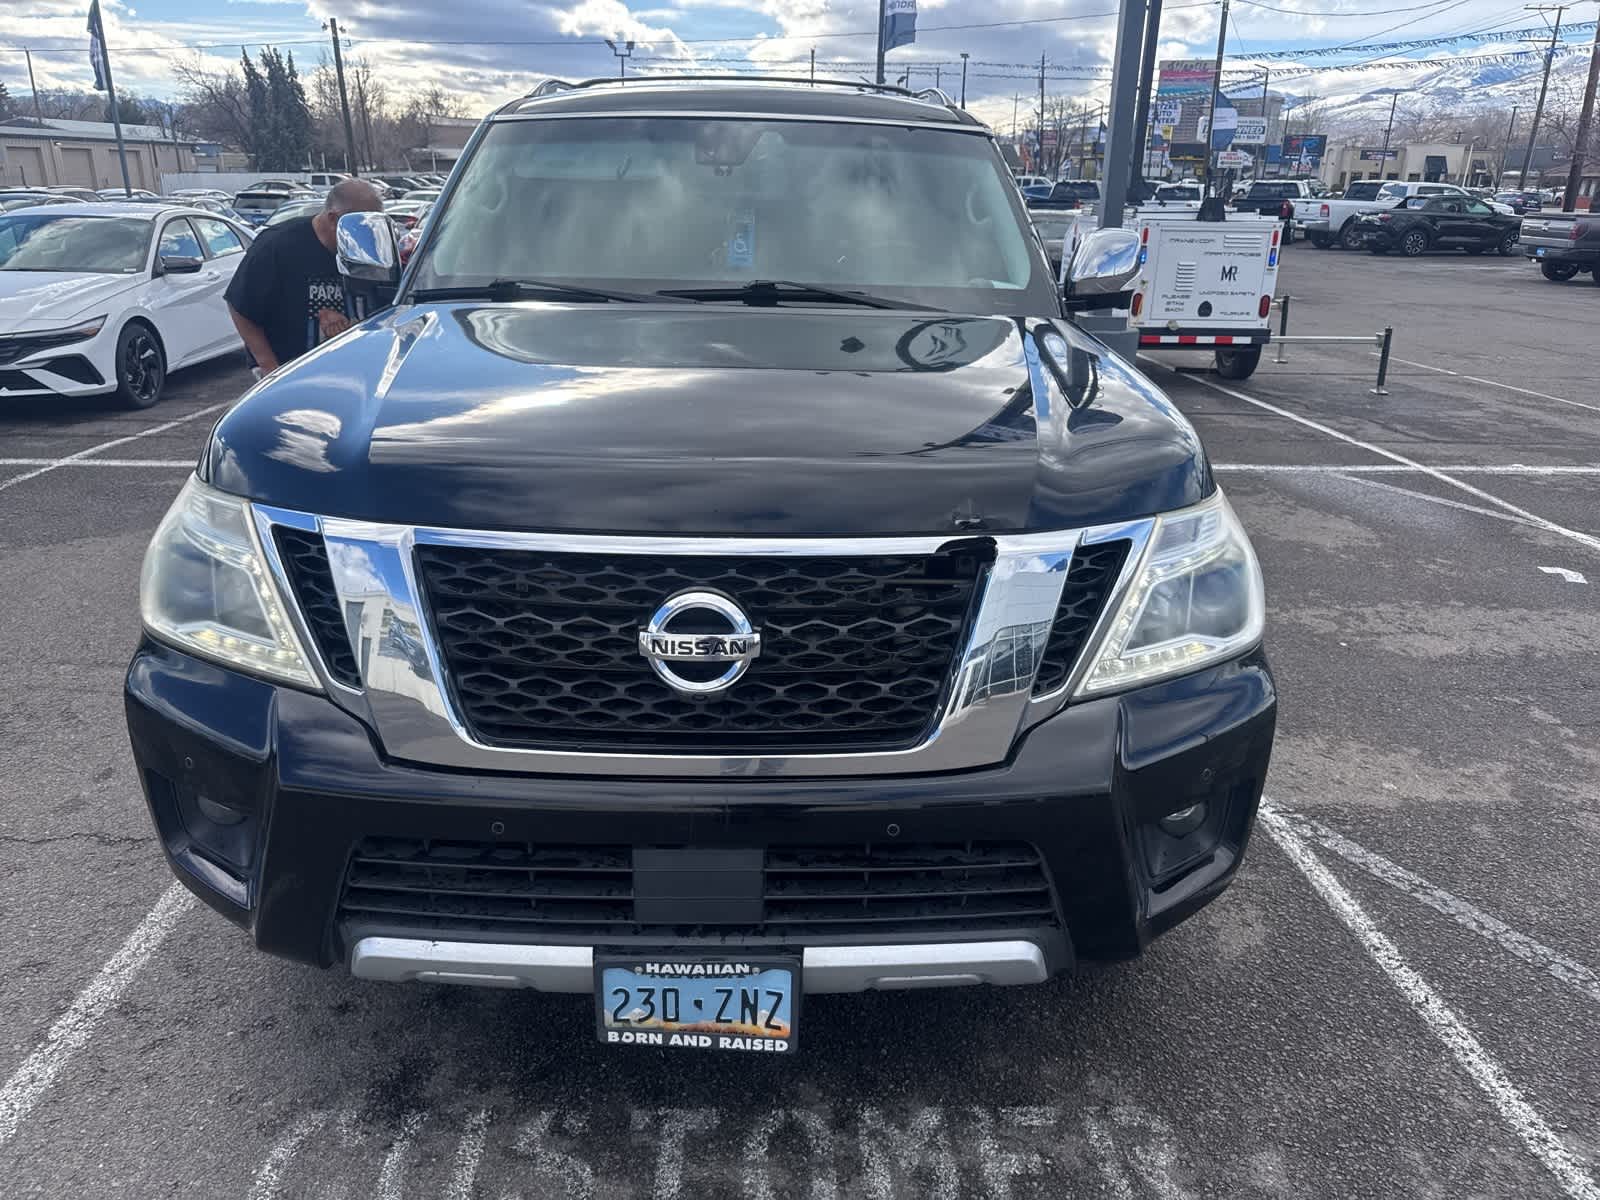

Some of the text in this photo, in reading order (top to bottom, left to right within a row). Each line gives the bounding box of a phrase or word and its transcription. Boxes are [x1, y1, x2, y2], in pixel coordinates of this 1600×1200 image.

[1221, 265, 1238, 281] MR
[309, 285, 344, 299] PAPA
[651, 639, 747, 656] NISSAN
[645, 963, 750, 975] HAWAIIAN
[612, 987, 784, 1030] 230 ZNZ
[607, 1031, 789, 1052] BORN AND RAISED
